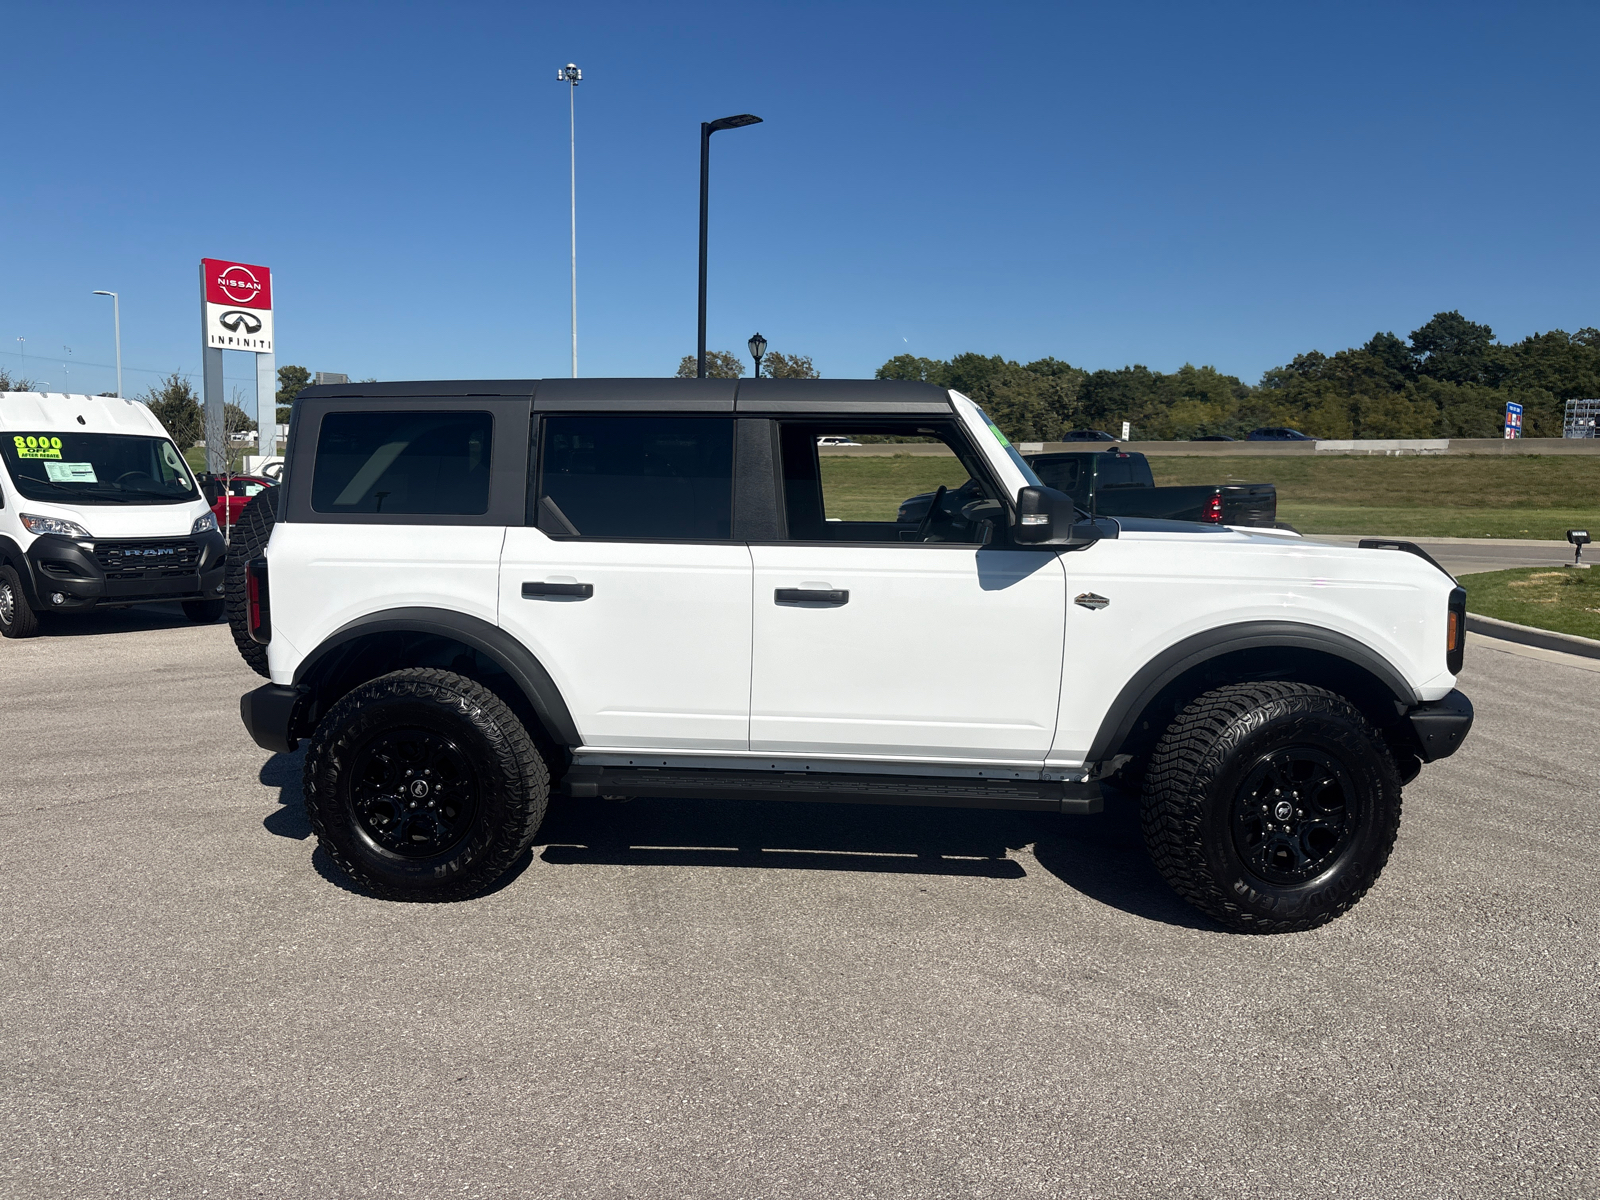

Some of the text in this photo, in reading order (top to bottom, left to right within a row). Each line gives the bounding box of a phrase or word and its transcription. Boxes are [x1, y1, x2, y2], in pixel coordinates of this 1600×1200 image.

[218, 278, 261, 290] NISSAN
[211, 335, 271, 349] INFINITI
[13, 436, 62, 449] 8000
